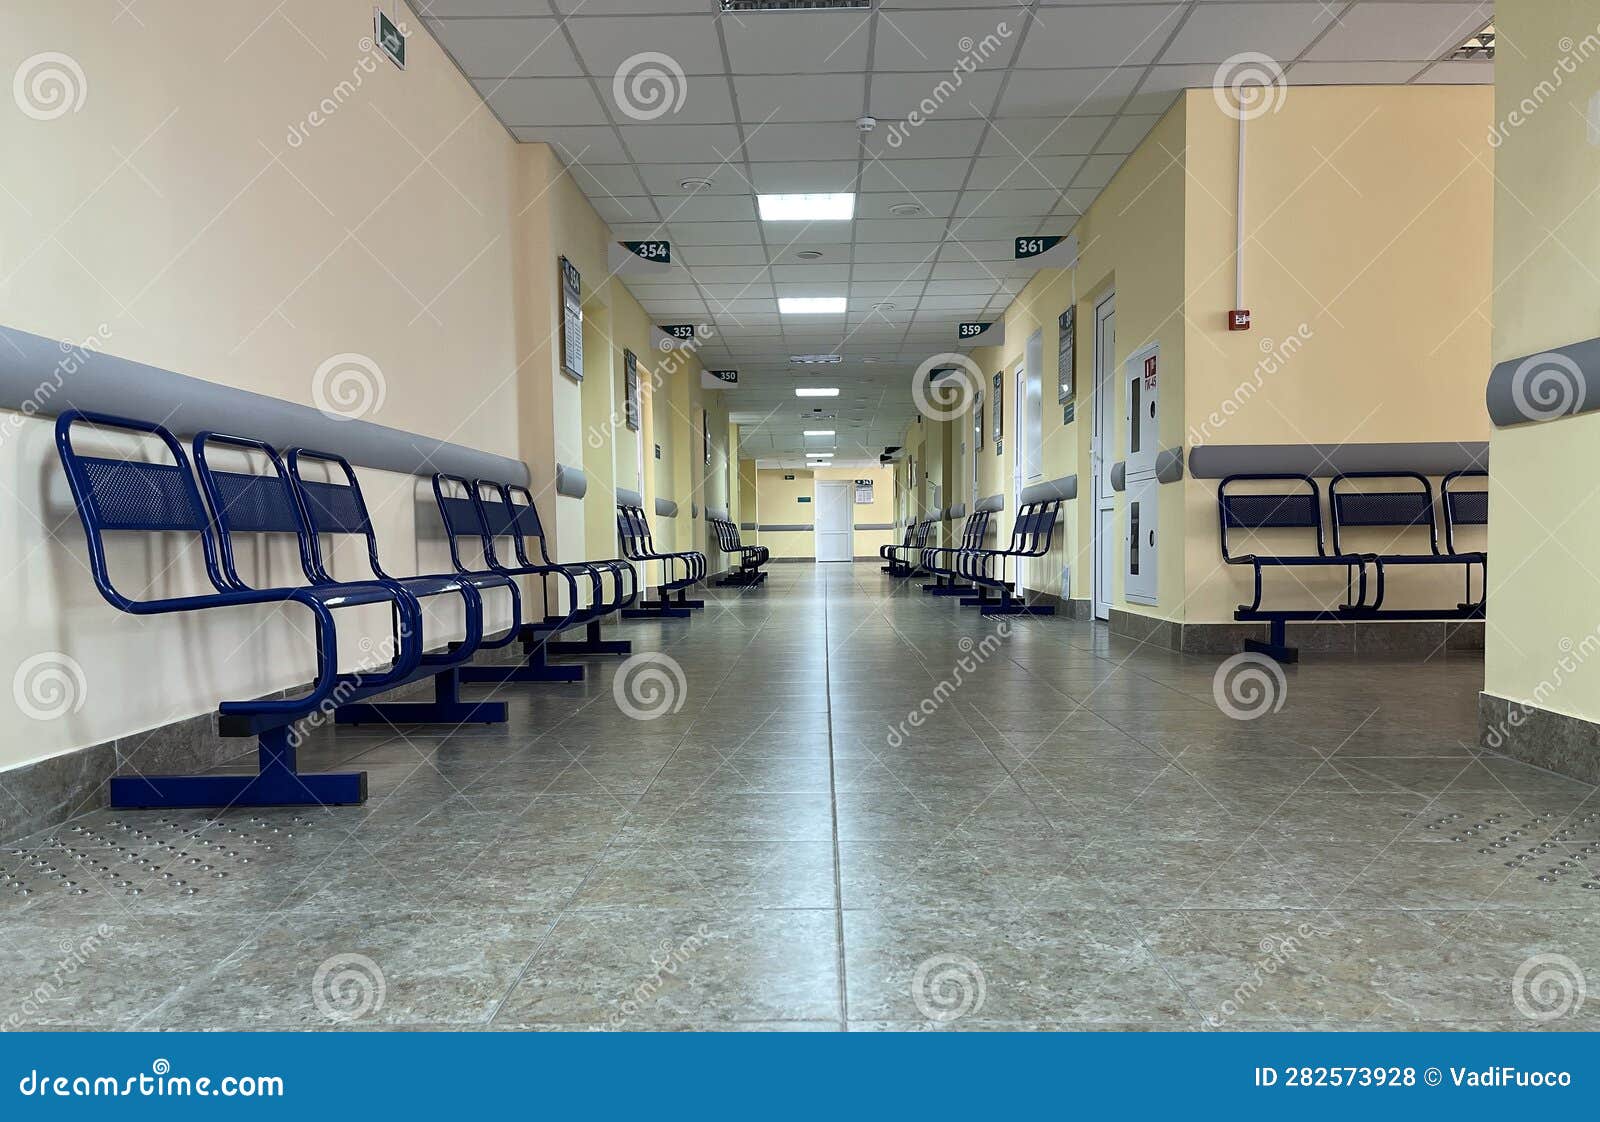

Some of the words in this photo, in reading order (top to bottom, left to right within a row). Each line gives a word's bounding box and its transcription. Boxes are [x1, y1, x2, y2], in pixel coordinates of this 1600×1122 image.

[639, 243, 666, 258] 354
[1018, 239, 1044, 253] 361
[673, 326, 692, 337] 352
[961, 325, 981, 335] 359
[720, 372, 736, 381] 350
